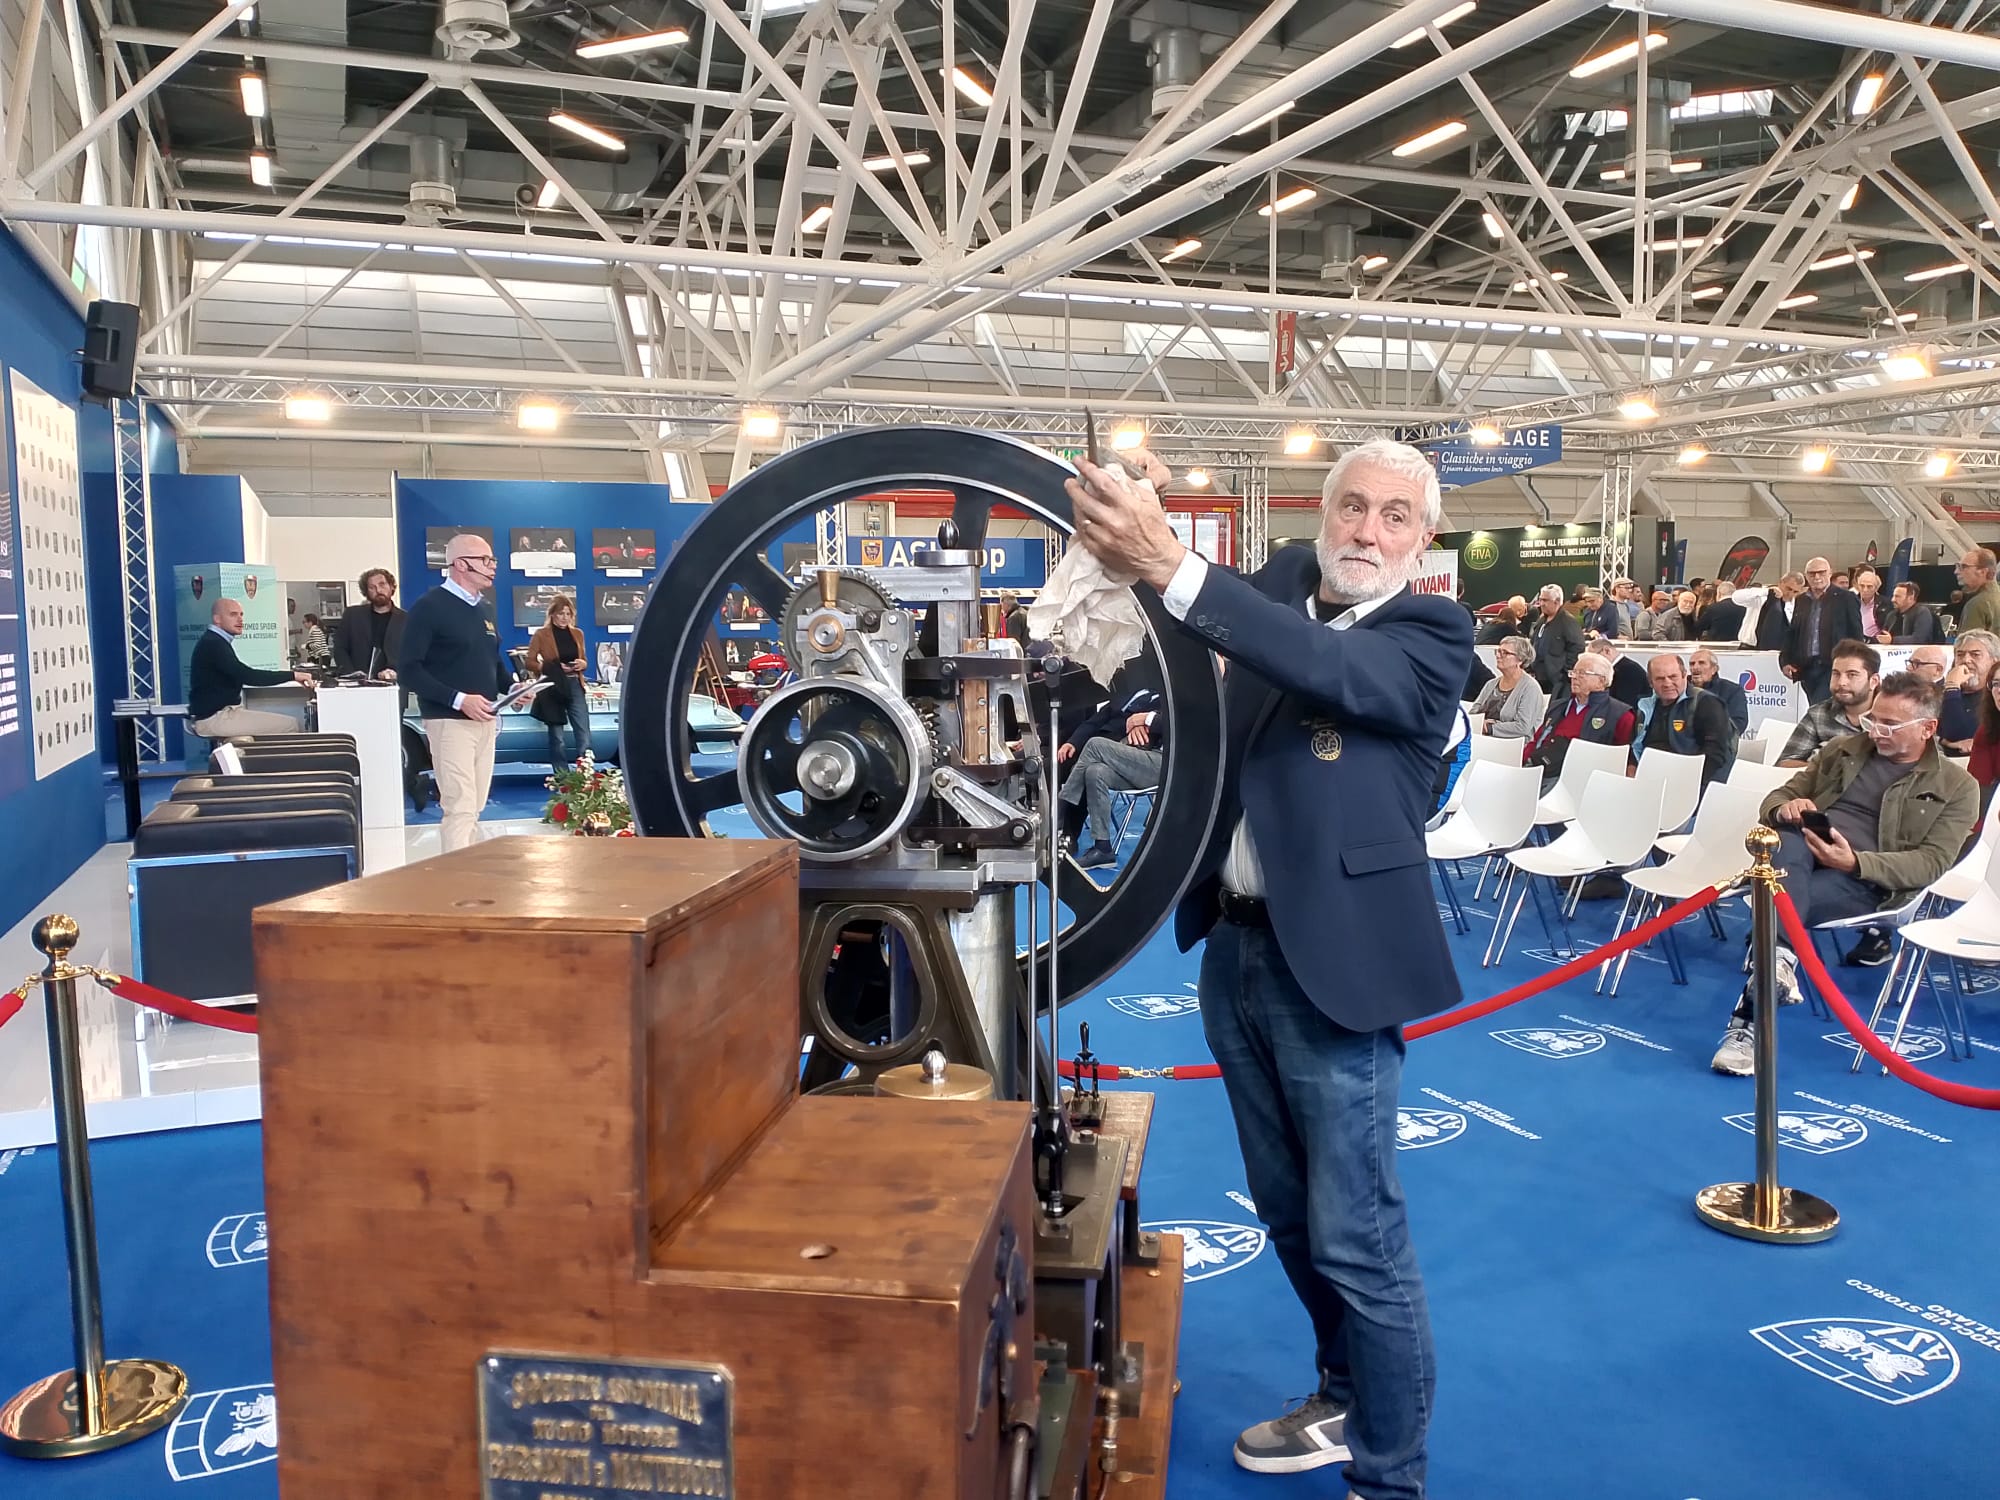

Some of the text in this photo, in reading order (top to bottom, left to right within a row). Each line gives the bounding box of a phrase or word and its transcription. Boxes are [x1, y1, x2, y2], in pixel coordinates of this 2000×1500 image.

[1468, 429, 1550, 447] LAGE
[1441, 451, 1533, 469] Classiche in viaggio
[1547, 538, 1556, 547] ALL
[1470, 547, 1492, 561] FIVA
[1520, 549, 1552, 559] CERTIFICATES
[1554, 548, 1567, 557] WILL
[1567, 547, 1589, 557] INCLUDE
[260, 622, 277, 630] SPIDER
[1758, 683, 1787, 696] europ
[1746, 695, 1787, 707] sistance
[1413, 1112, 1461, 1130] ASI
[1793, 1090, 1953, 1143] AUTOMOTOCLUB STORICO
[1804, 1115, 1861, 1133] ASI
[1203, 1227, 1259, 1253] ASI
[1845, 1279, 1923, 1313] STORICO
[1865, 1326, 1951, 1361] ASI
[532, 1417, 679, 1449] NUOVO MOTORE
